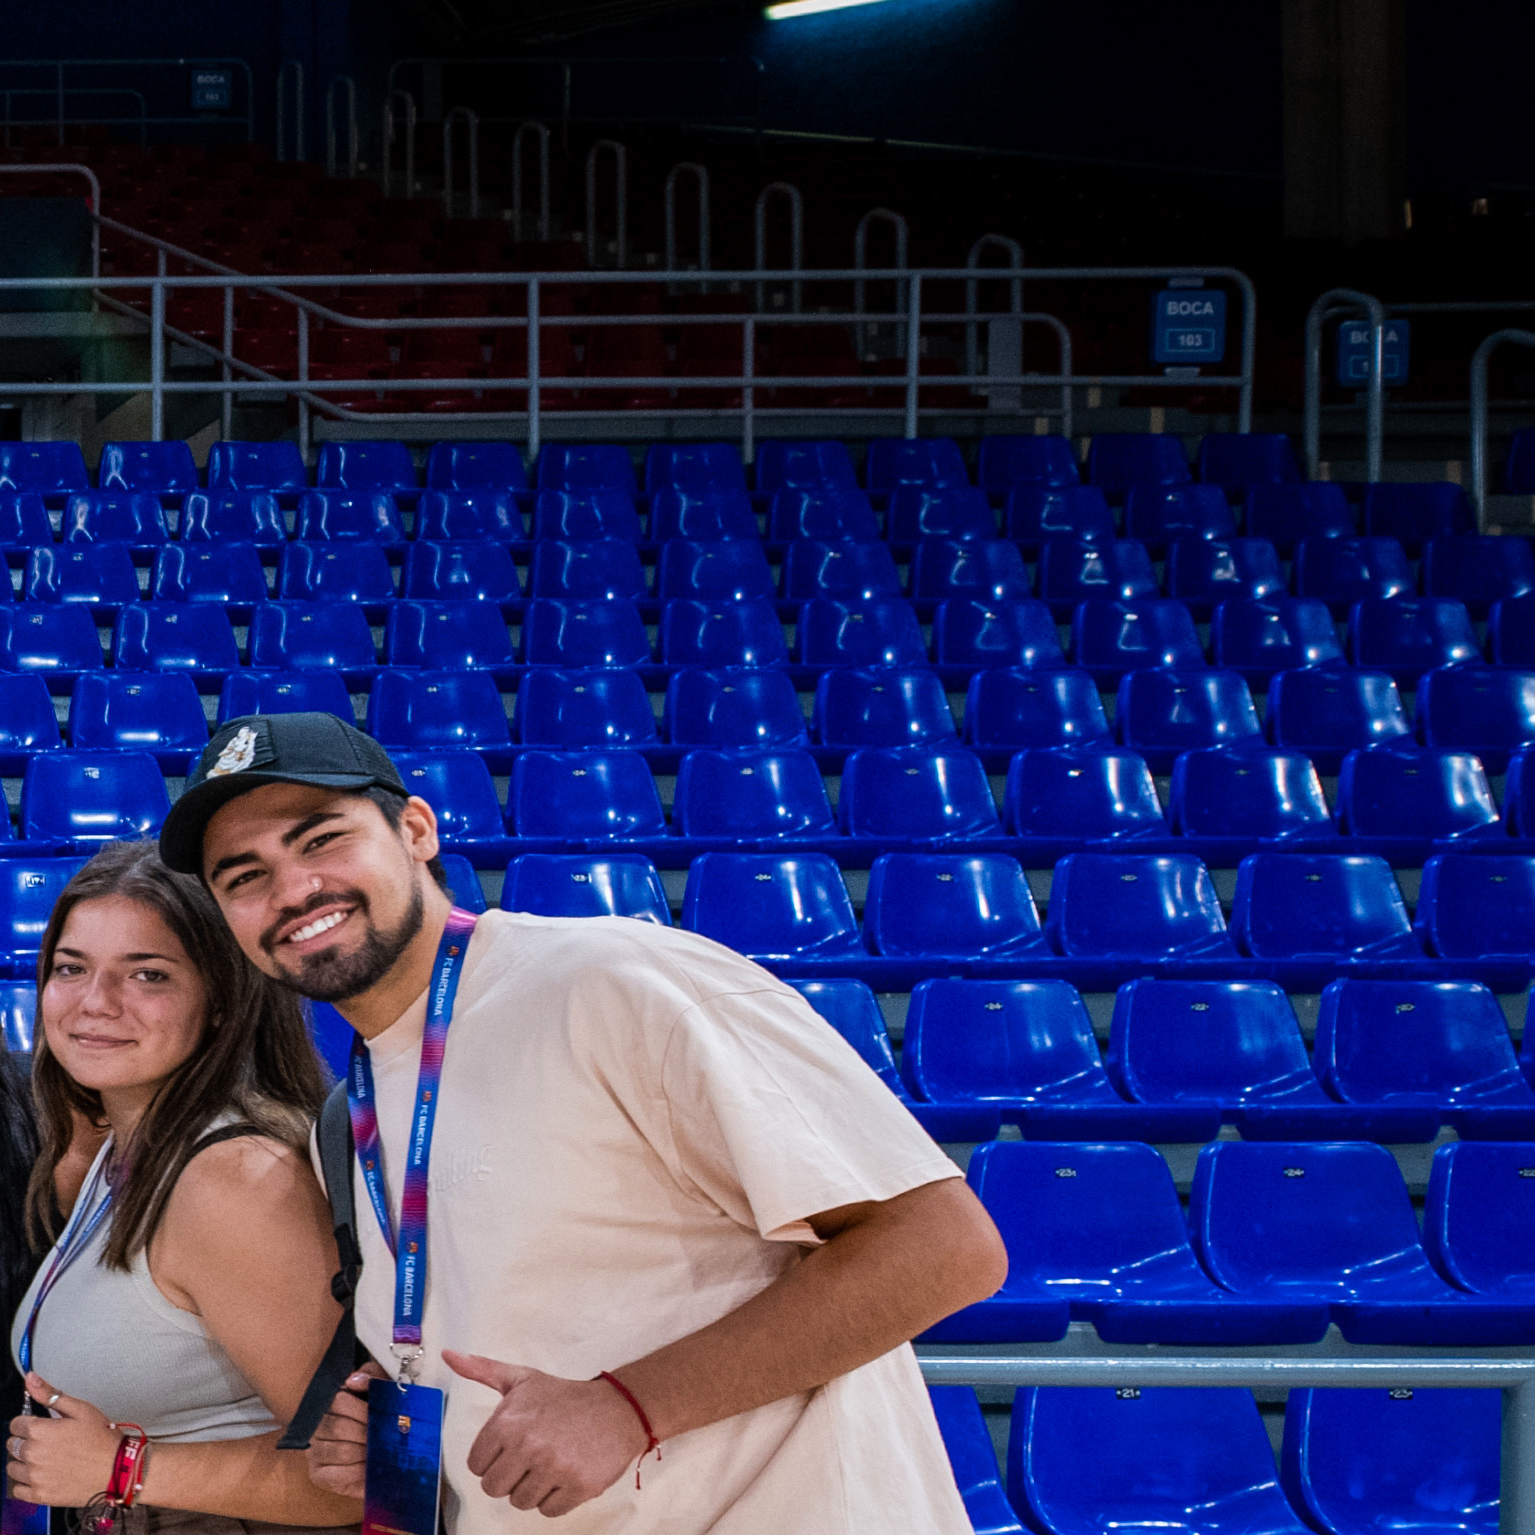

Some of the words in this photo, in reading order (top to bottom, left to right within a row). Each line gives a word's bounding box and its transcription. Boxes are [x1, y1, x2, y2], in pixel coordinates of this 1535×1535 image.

[1166, 301, 1213, 315] BOCA
[1178, 336, 1202, 347] 103
[1351, 331, 1399, 343] BOA
[433, 967, 452, 1016] BARCELONA
[414, 1115, 427, 1165] BARCELONA
[402, 1266, 415, 1316] BARCELONA
